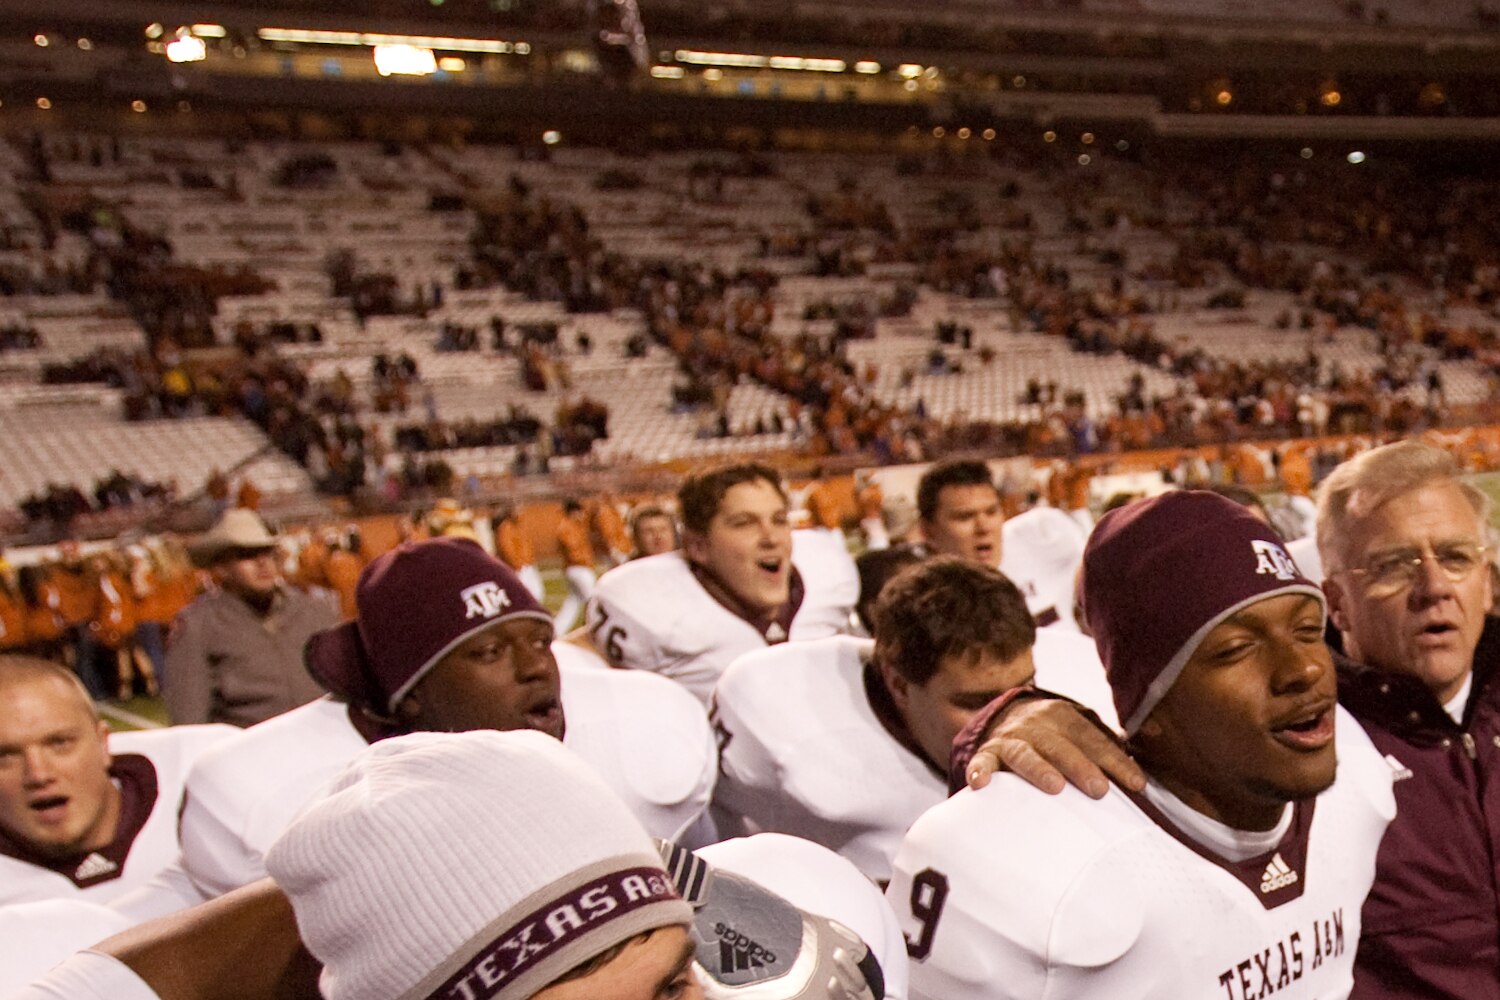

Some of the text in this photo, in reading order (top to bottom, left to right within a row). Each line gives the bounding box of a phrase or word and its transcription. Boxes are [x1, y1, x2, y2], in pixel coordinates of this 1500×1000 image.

[1260, 870, 1299, 894] adidas
[902, 866, 950, 964] 9
[1312, 906, 1345, 971] A&M
[714, 922, 777, 964] adidas
